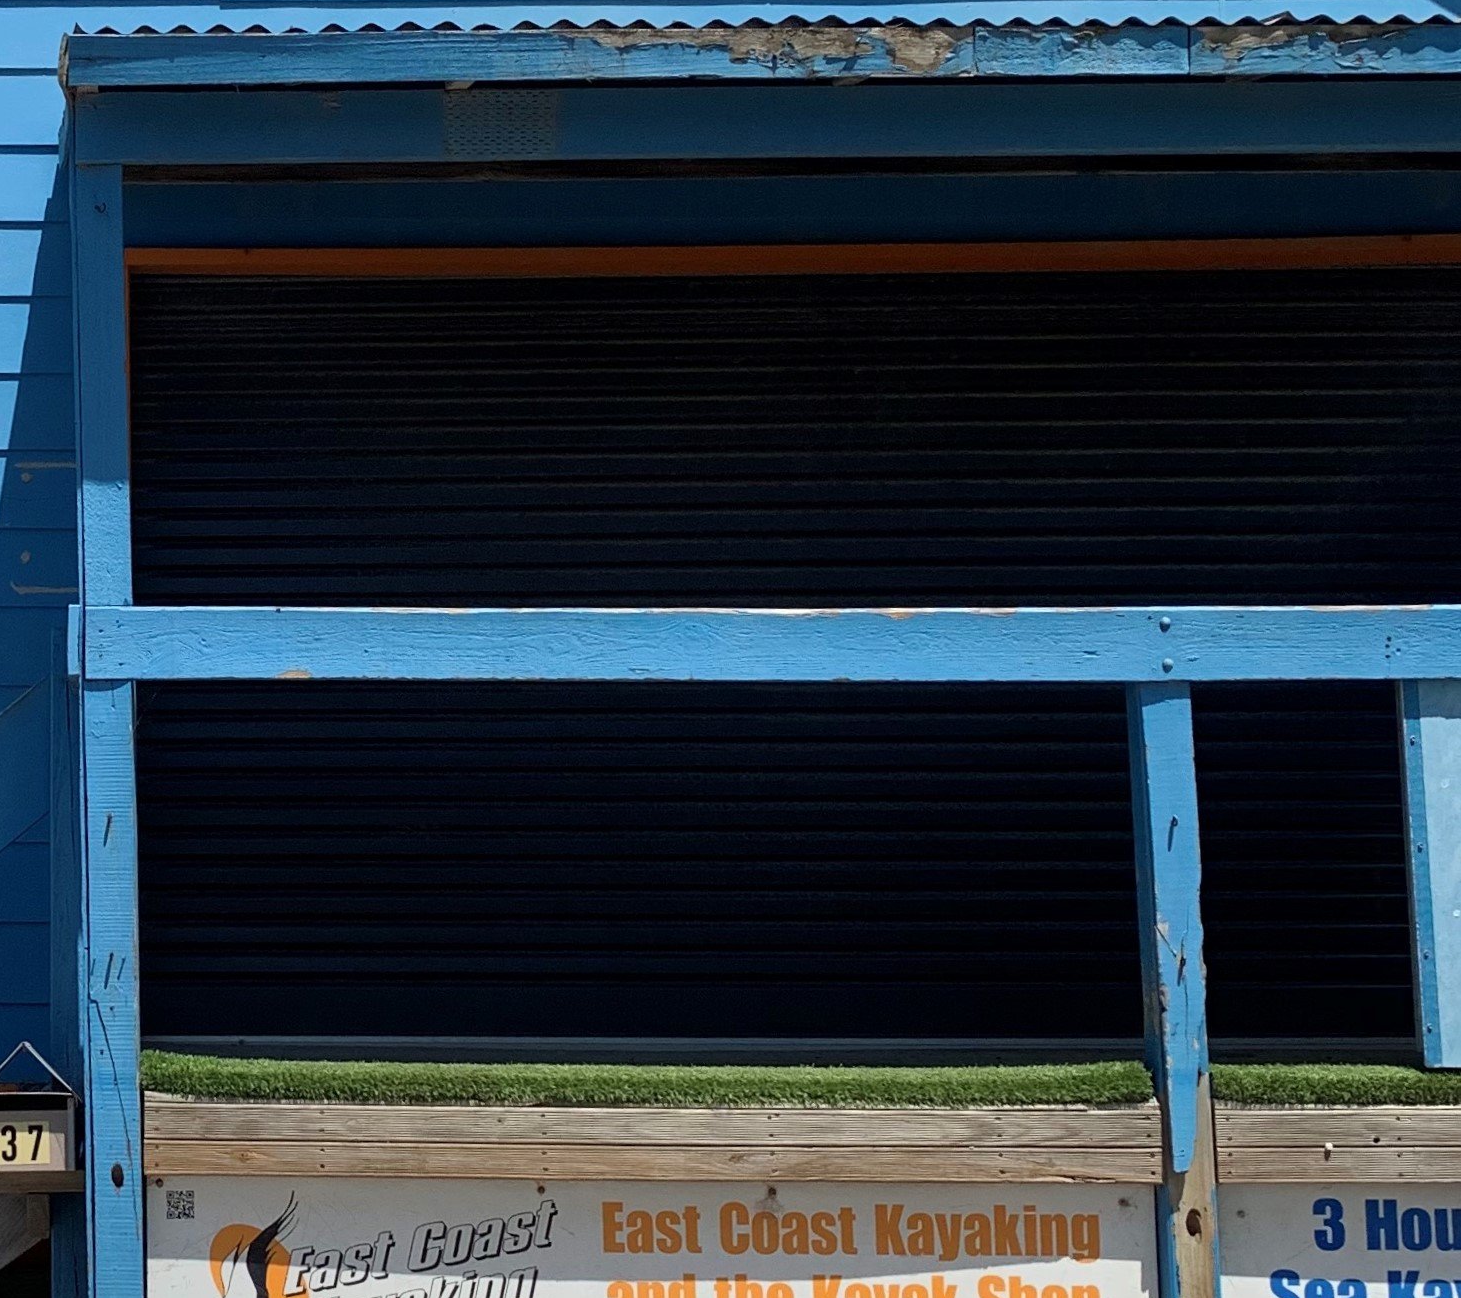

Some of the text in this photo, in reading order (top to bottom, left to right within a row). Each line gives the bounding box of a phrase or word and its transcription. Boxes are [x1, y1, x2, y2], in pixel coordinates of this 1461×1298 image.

[0, 1124, 44, 1162] 37
[283, 1198, 557, 1297] East Coast
[601, 1202, 1101, 1264] East Coast Kayaking
[1312, 1197, 1346, 1252] 3
